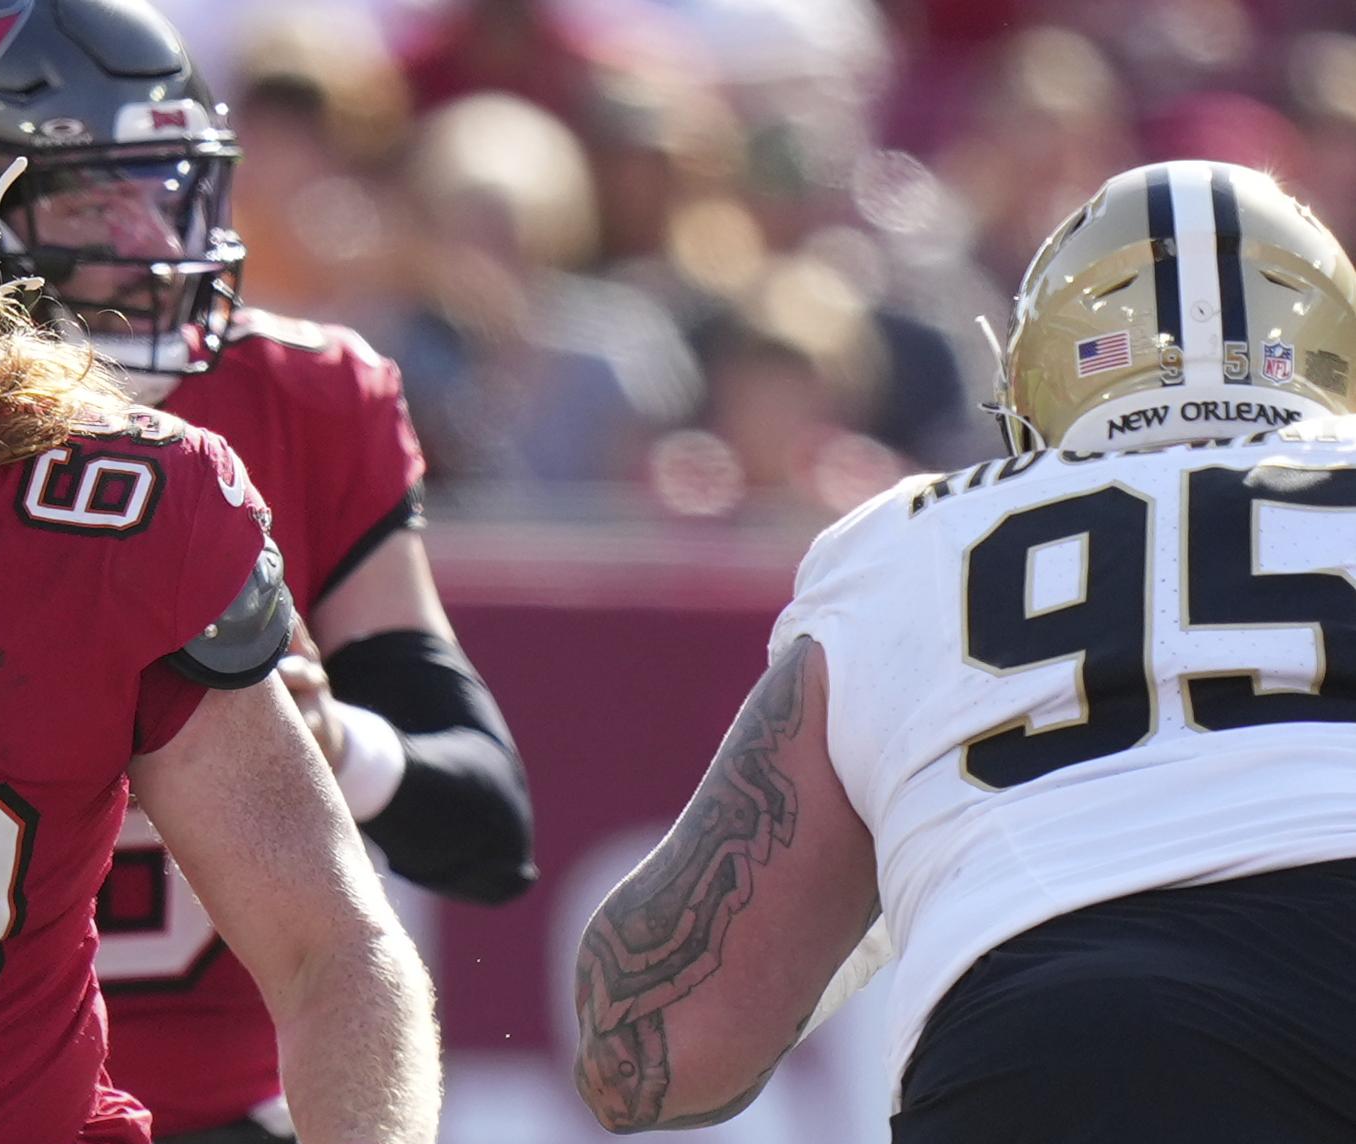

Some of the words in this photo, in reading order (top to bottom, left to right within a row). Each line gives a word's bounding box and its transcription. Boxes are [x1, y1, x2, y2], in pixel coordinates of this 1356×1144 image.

[1265, 359, 1291, 379] NFL
[1107, 405, 1169, 440] NEW
[1181, 400, 1303, 426] ORLEANS
[960, 478, 1356, 791] 95
